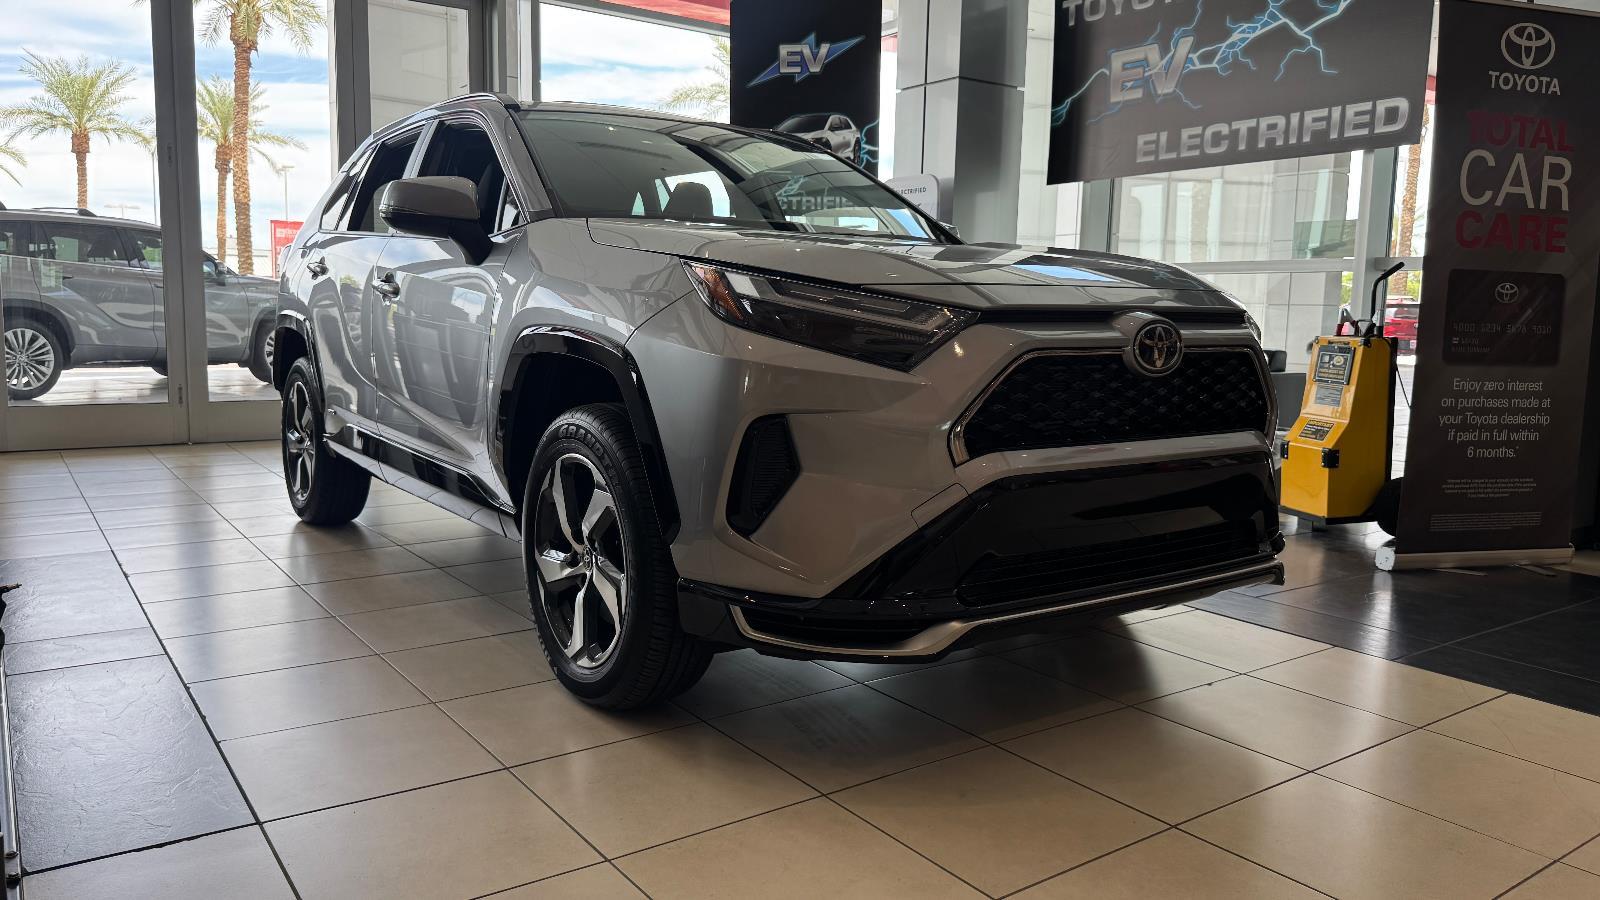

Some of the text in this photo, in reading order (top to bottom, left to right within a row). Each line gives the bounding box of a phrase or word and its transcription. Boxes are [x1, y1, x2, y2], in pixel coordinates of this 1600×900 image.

[779, 43, 830, 73] EV
[1110, 36, 1194, 103] EV
[1488, 70, 1561, 95] TOYOTA
[1135, 97, 1410, 163] ELECTRIFIED
[1467, 108, 1575, 153] TOTAL
[1460, 149, 1572, 211] CAR
[1455, 209, 1569, 254] CARE
[1453, 378, 1543, 392] Enjoy zero interest
[1441, 396, 1551, 410] on purchases made at
[1439, 412, 1550, 427] your Toyota dealership
[1447, 429, 1540, 443] if paid in full within
[1467, 446, 1474, 458] 6
